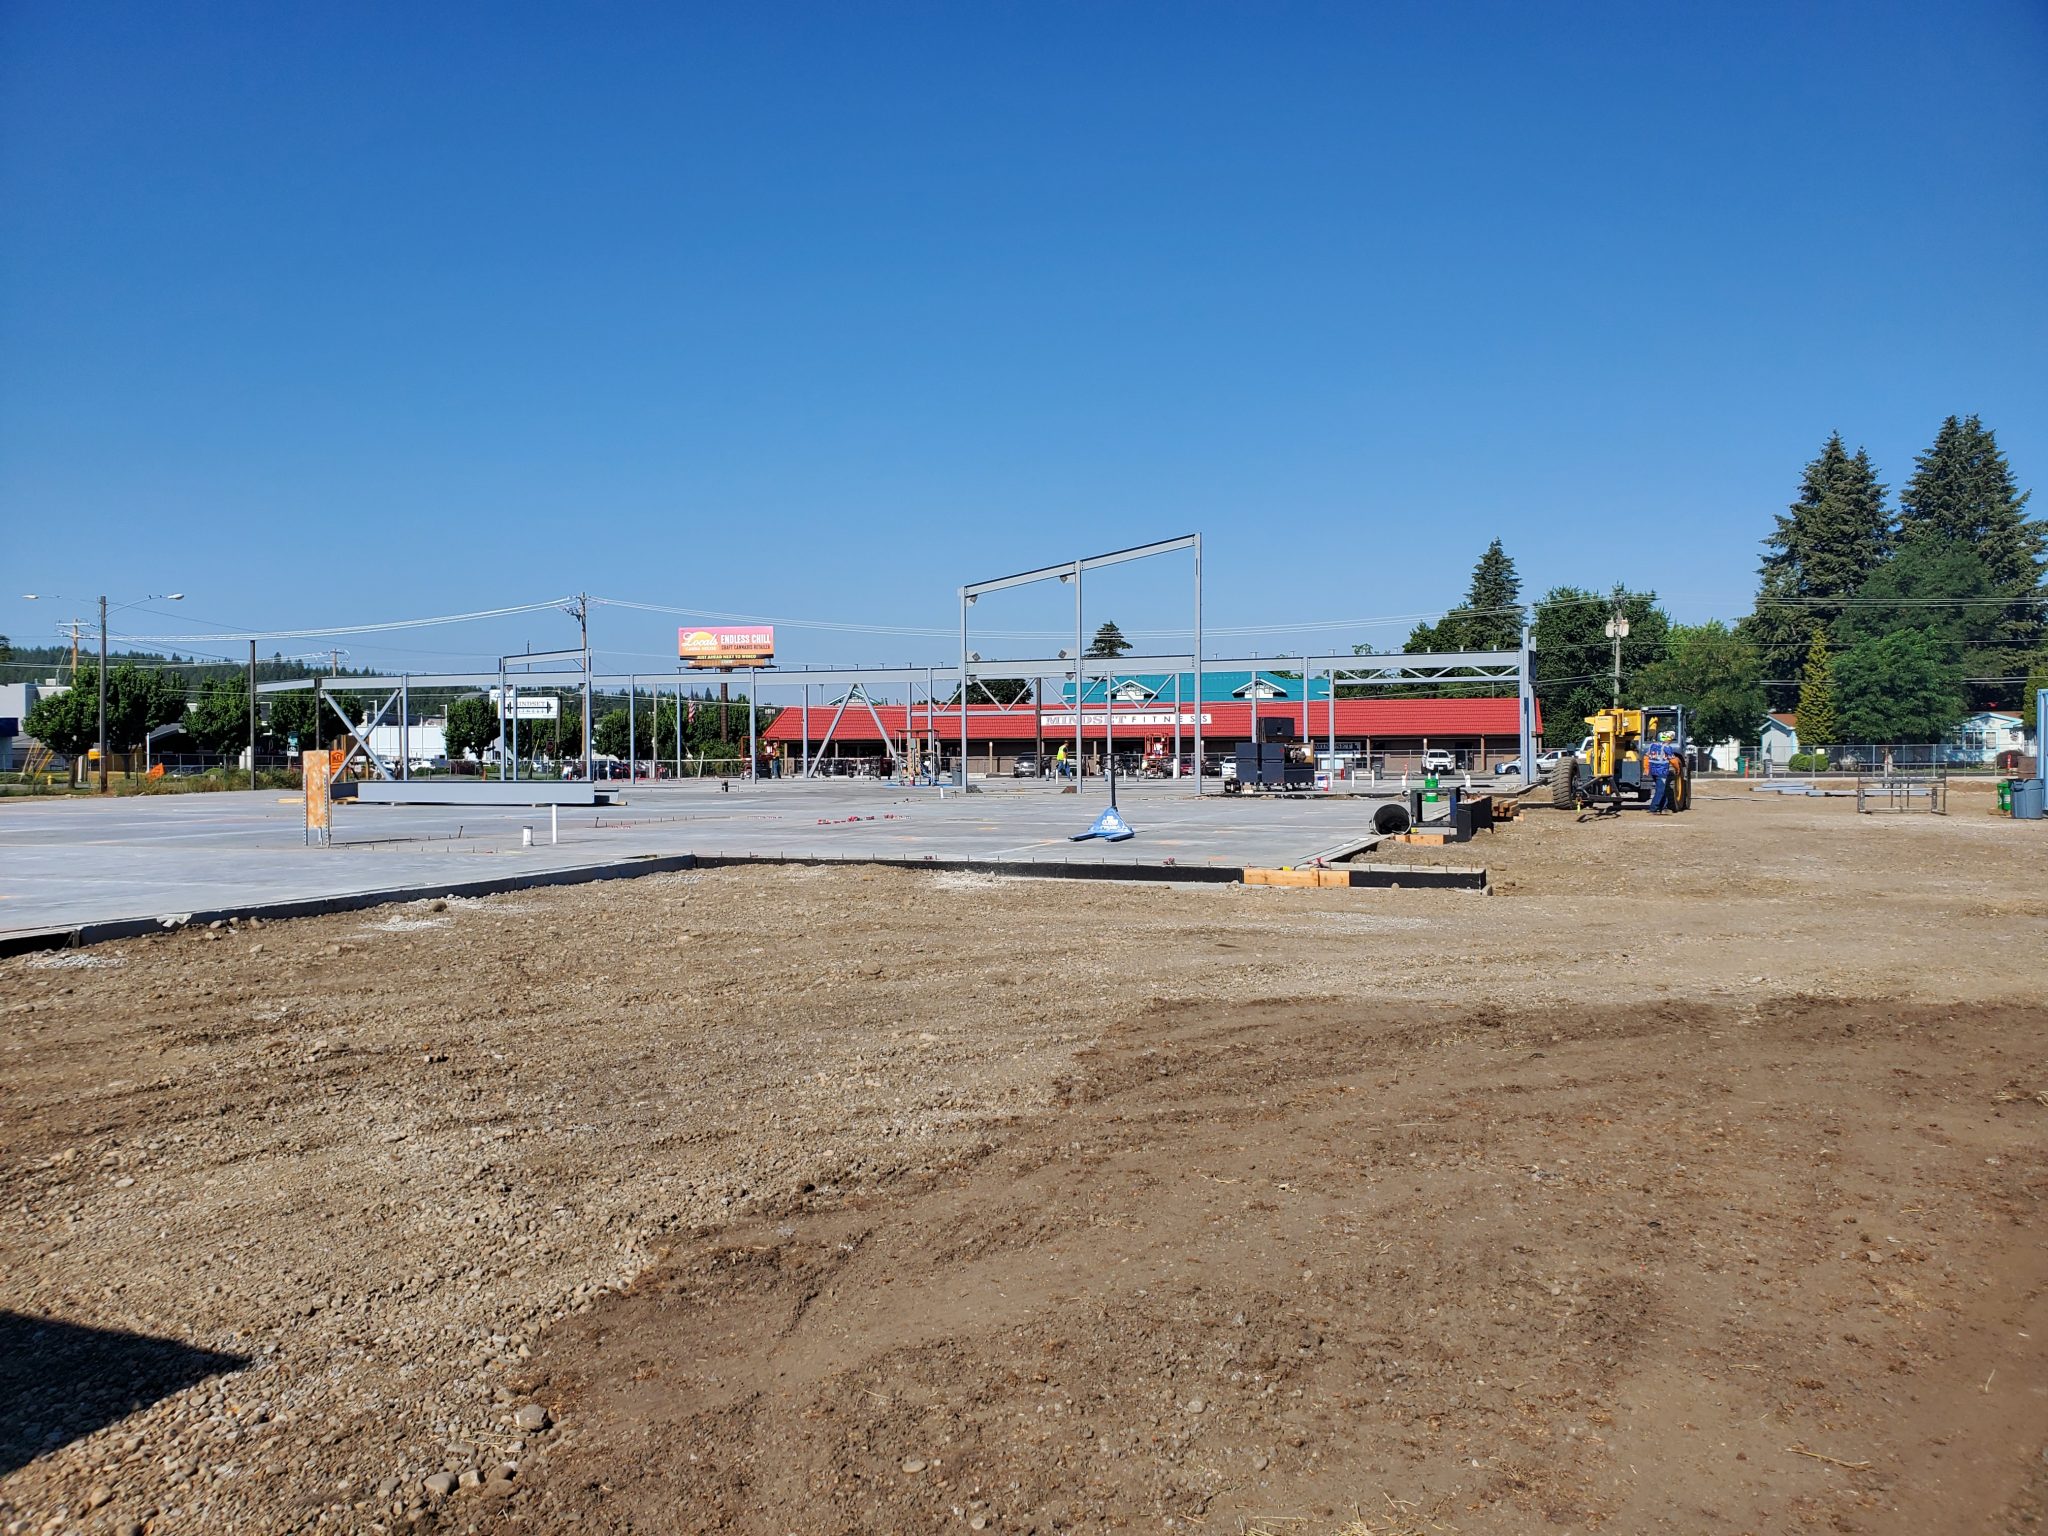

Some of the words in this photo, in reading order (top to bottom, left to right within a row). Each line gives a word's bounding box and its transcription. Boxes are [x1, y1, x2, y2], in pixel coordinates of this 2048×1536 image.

[682, 632, 717, 646] Locals
[721, 634, 749, 644] ENDLESS
[752, 634, 770, 643] CHILL
